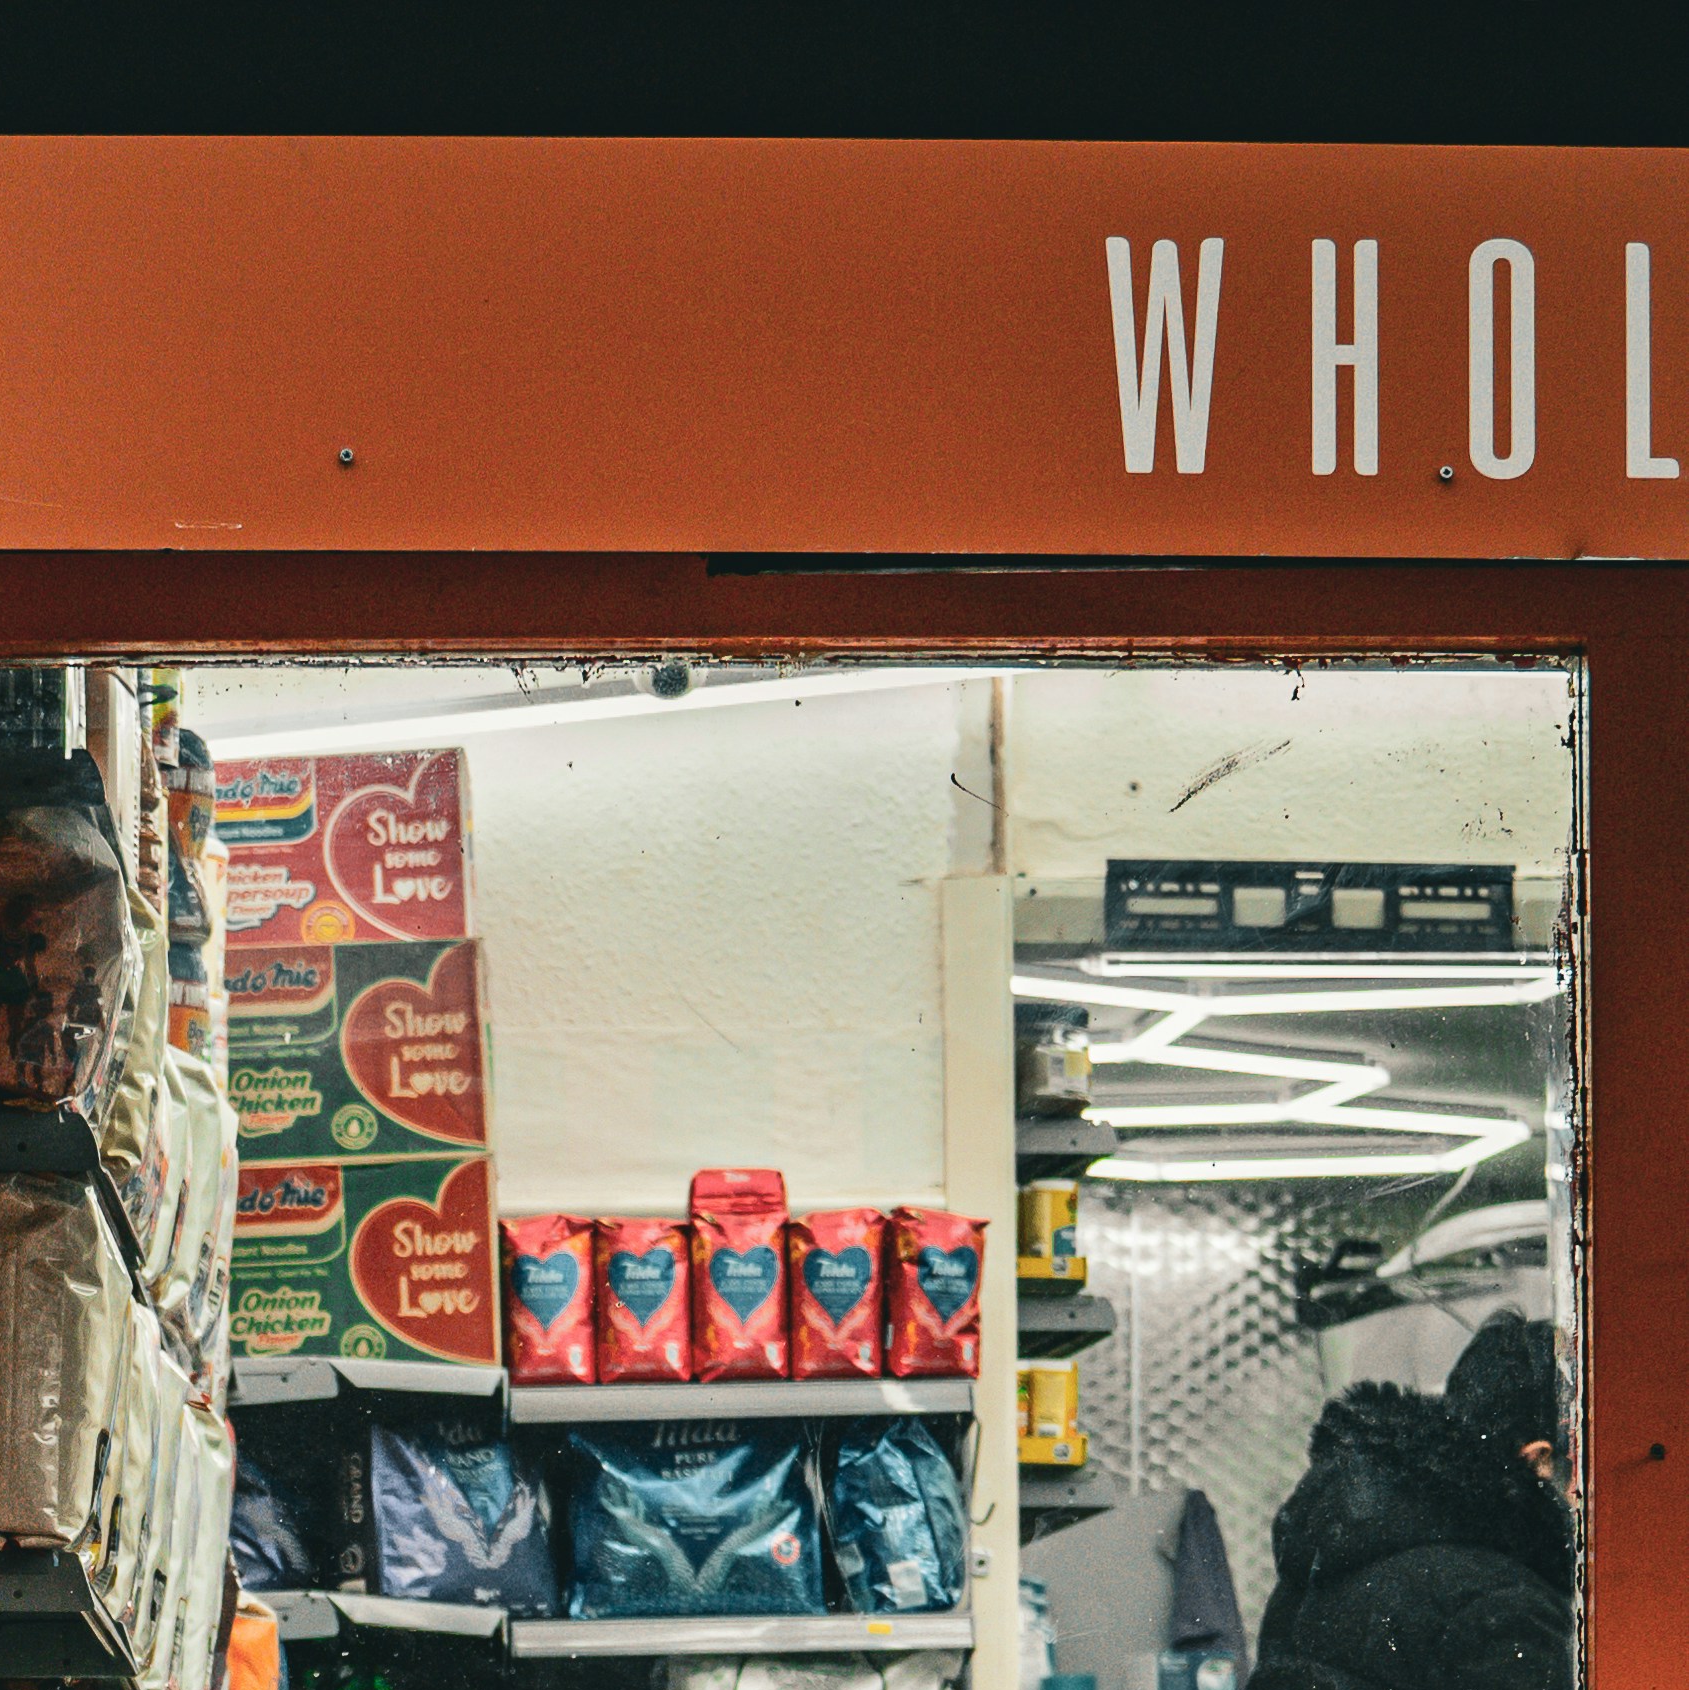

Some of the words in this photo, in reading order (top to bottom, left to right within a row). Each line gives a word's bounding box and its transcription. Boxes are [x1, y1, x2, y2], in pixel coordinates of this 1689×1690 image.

[1105, 236, 1680, 480] WHOL
[367, 808, 451, 846] Show
[385, 850, 441, 869] some
[372, 861, 453, 904] Love
[385, 1001, 468, 1039] Show
[234, 1070, 307, 1092] Onion
[390, 1055, 470, 1098] Love
[393, 1220, 480, 1258] Show
[243, 1290, 316, 1312] Onion
[398, 1276, 480, 1318] Love
[230, 1312, 326, 1335] Chicken
